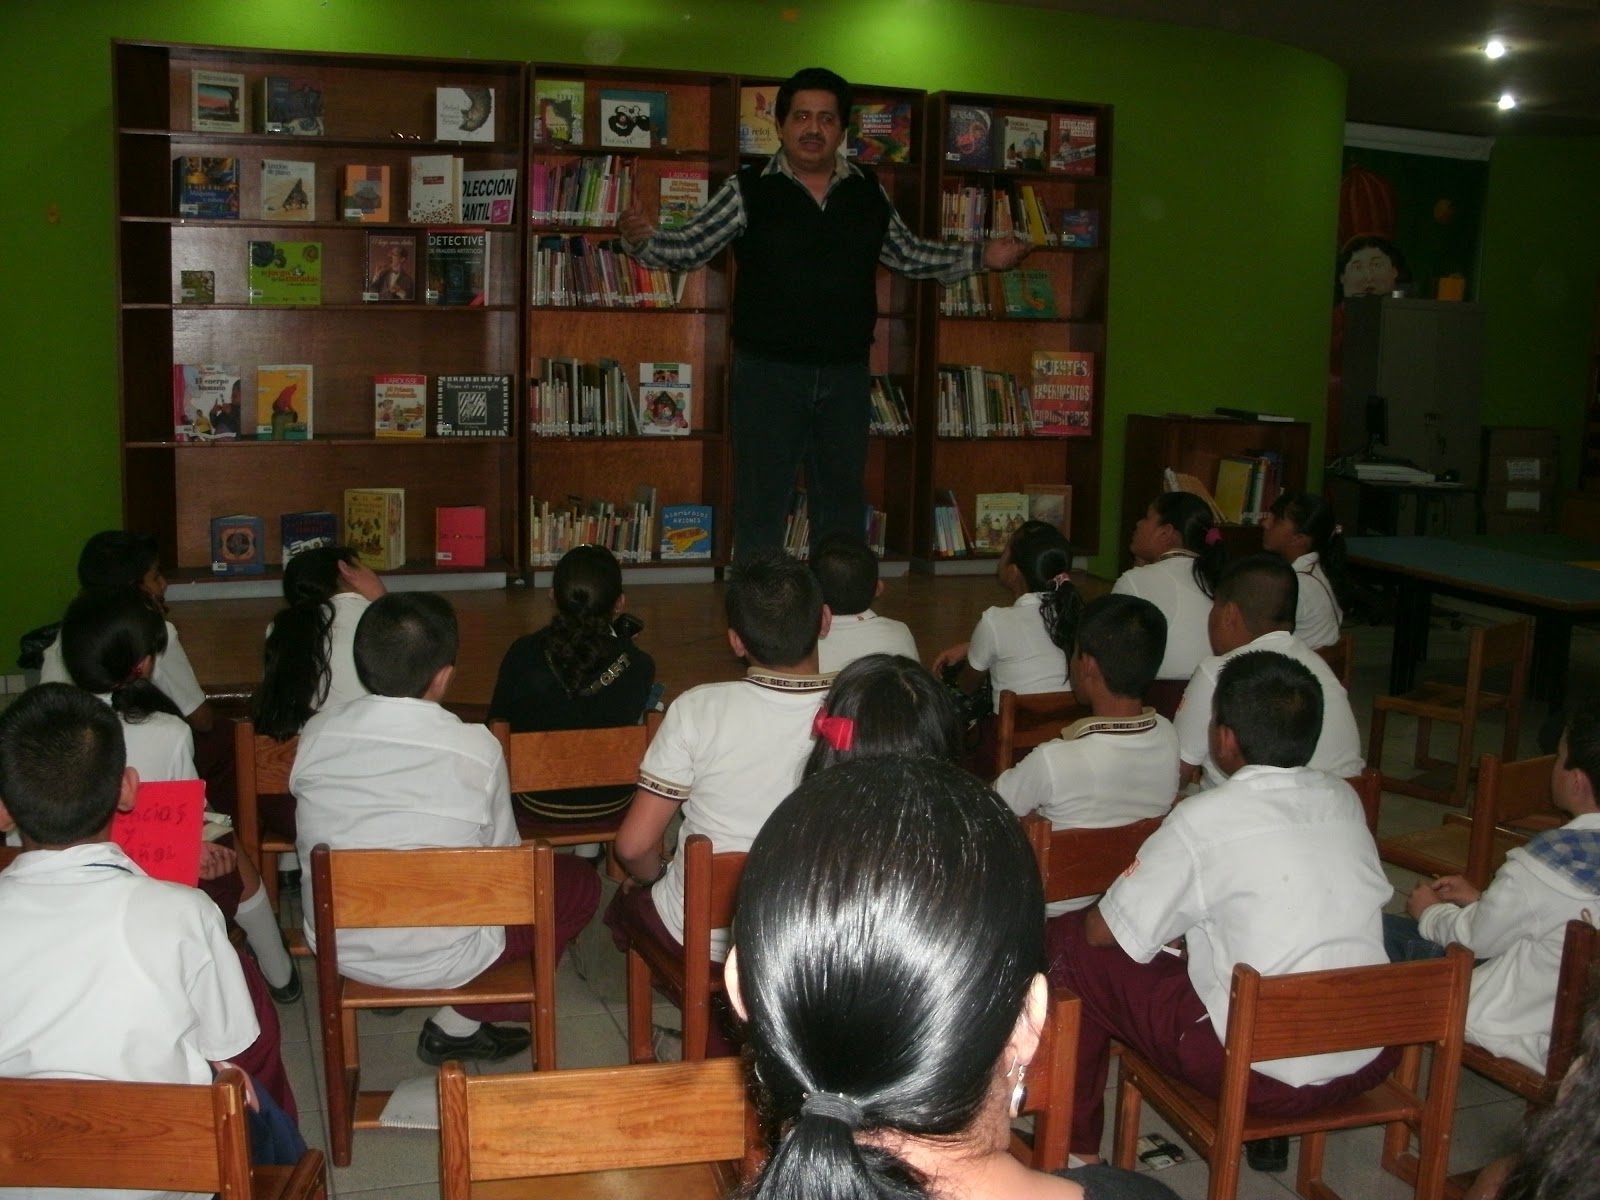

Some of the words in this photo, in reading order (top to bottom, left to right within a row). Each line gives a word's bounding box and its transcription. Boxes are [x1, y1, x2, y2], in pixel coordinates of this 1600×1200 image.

[742, 127, 750, 136] El
[752, 127, 770, 137] reloj
[463, 172, 514, 198] OLECCIÓN
[463, 203, 490, 222] ANTIL
[429, 235, 484, 246] DETECTIVE
[770, 678, 793, 688] SEC.
[796, 680, 819, 688] TEC.
[1089, 723, 1110, 731] ESC.
[651, 781, 662, 792] N.
